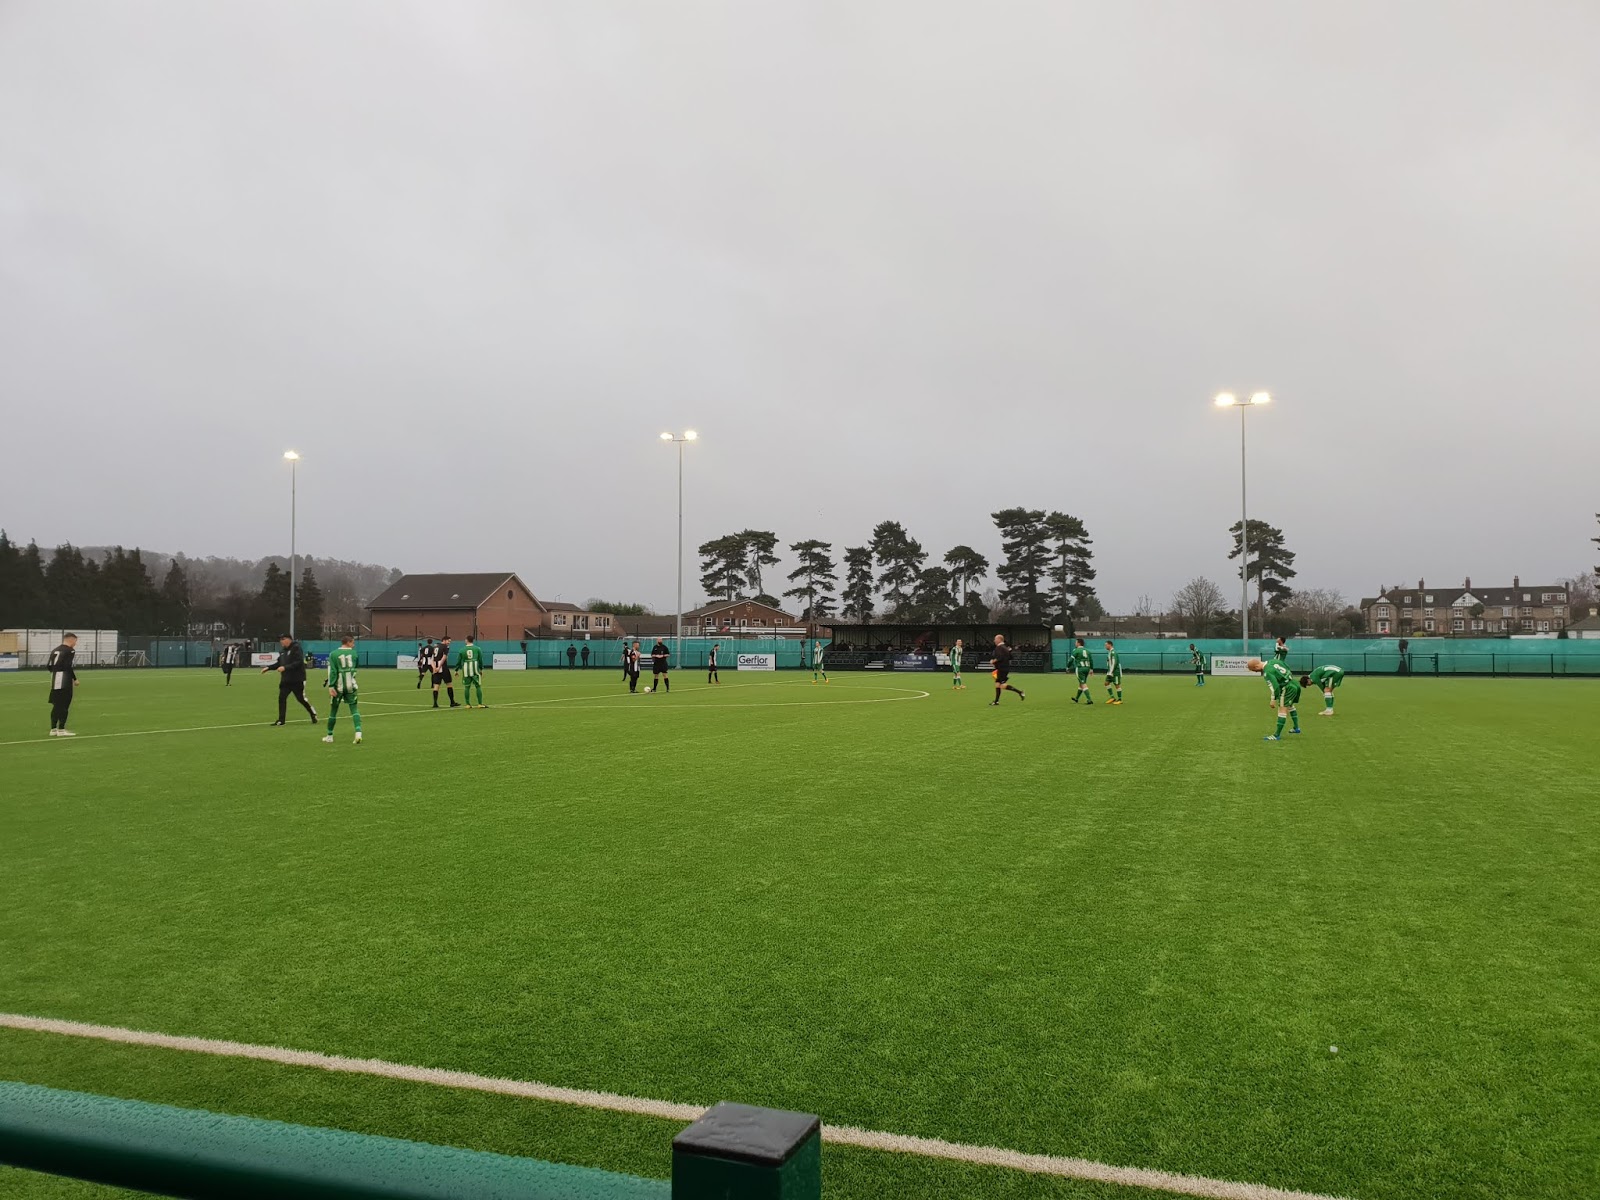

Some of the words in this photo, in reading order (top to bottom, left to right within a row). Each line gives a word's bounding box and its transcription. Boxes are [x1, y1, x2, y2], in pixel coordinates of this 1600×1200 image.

[53, 651, 60, 666] 7
[466, 649, 473, 659] 9
[738, 655, 768, 665] Gerflor
[338, 654, 353, 668] 11
